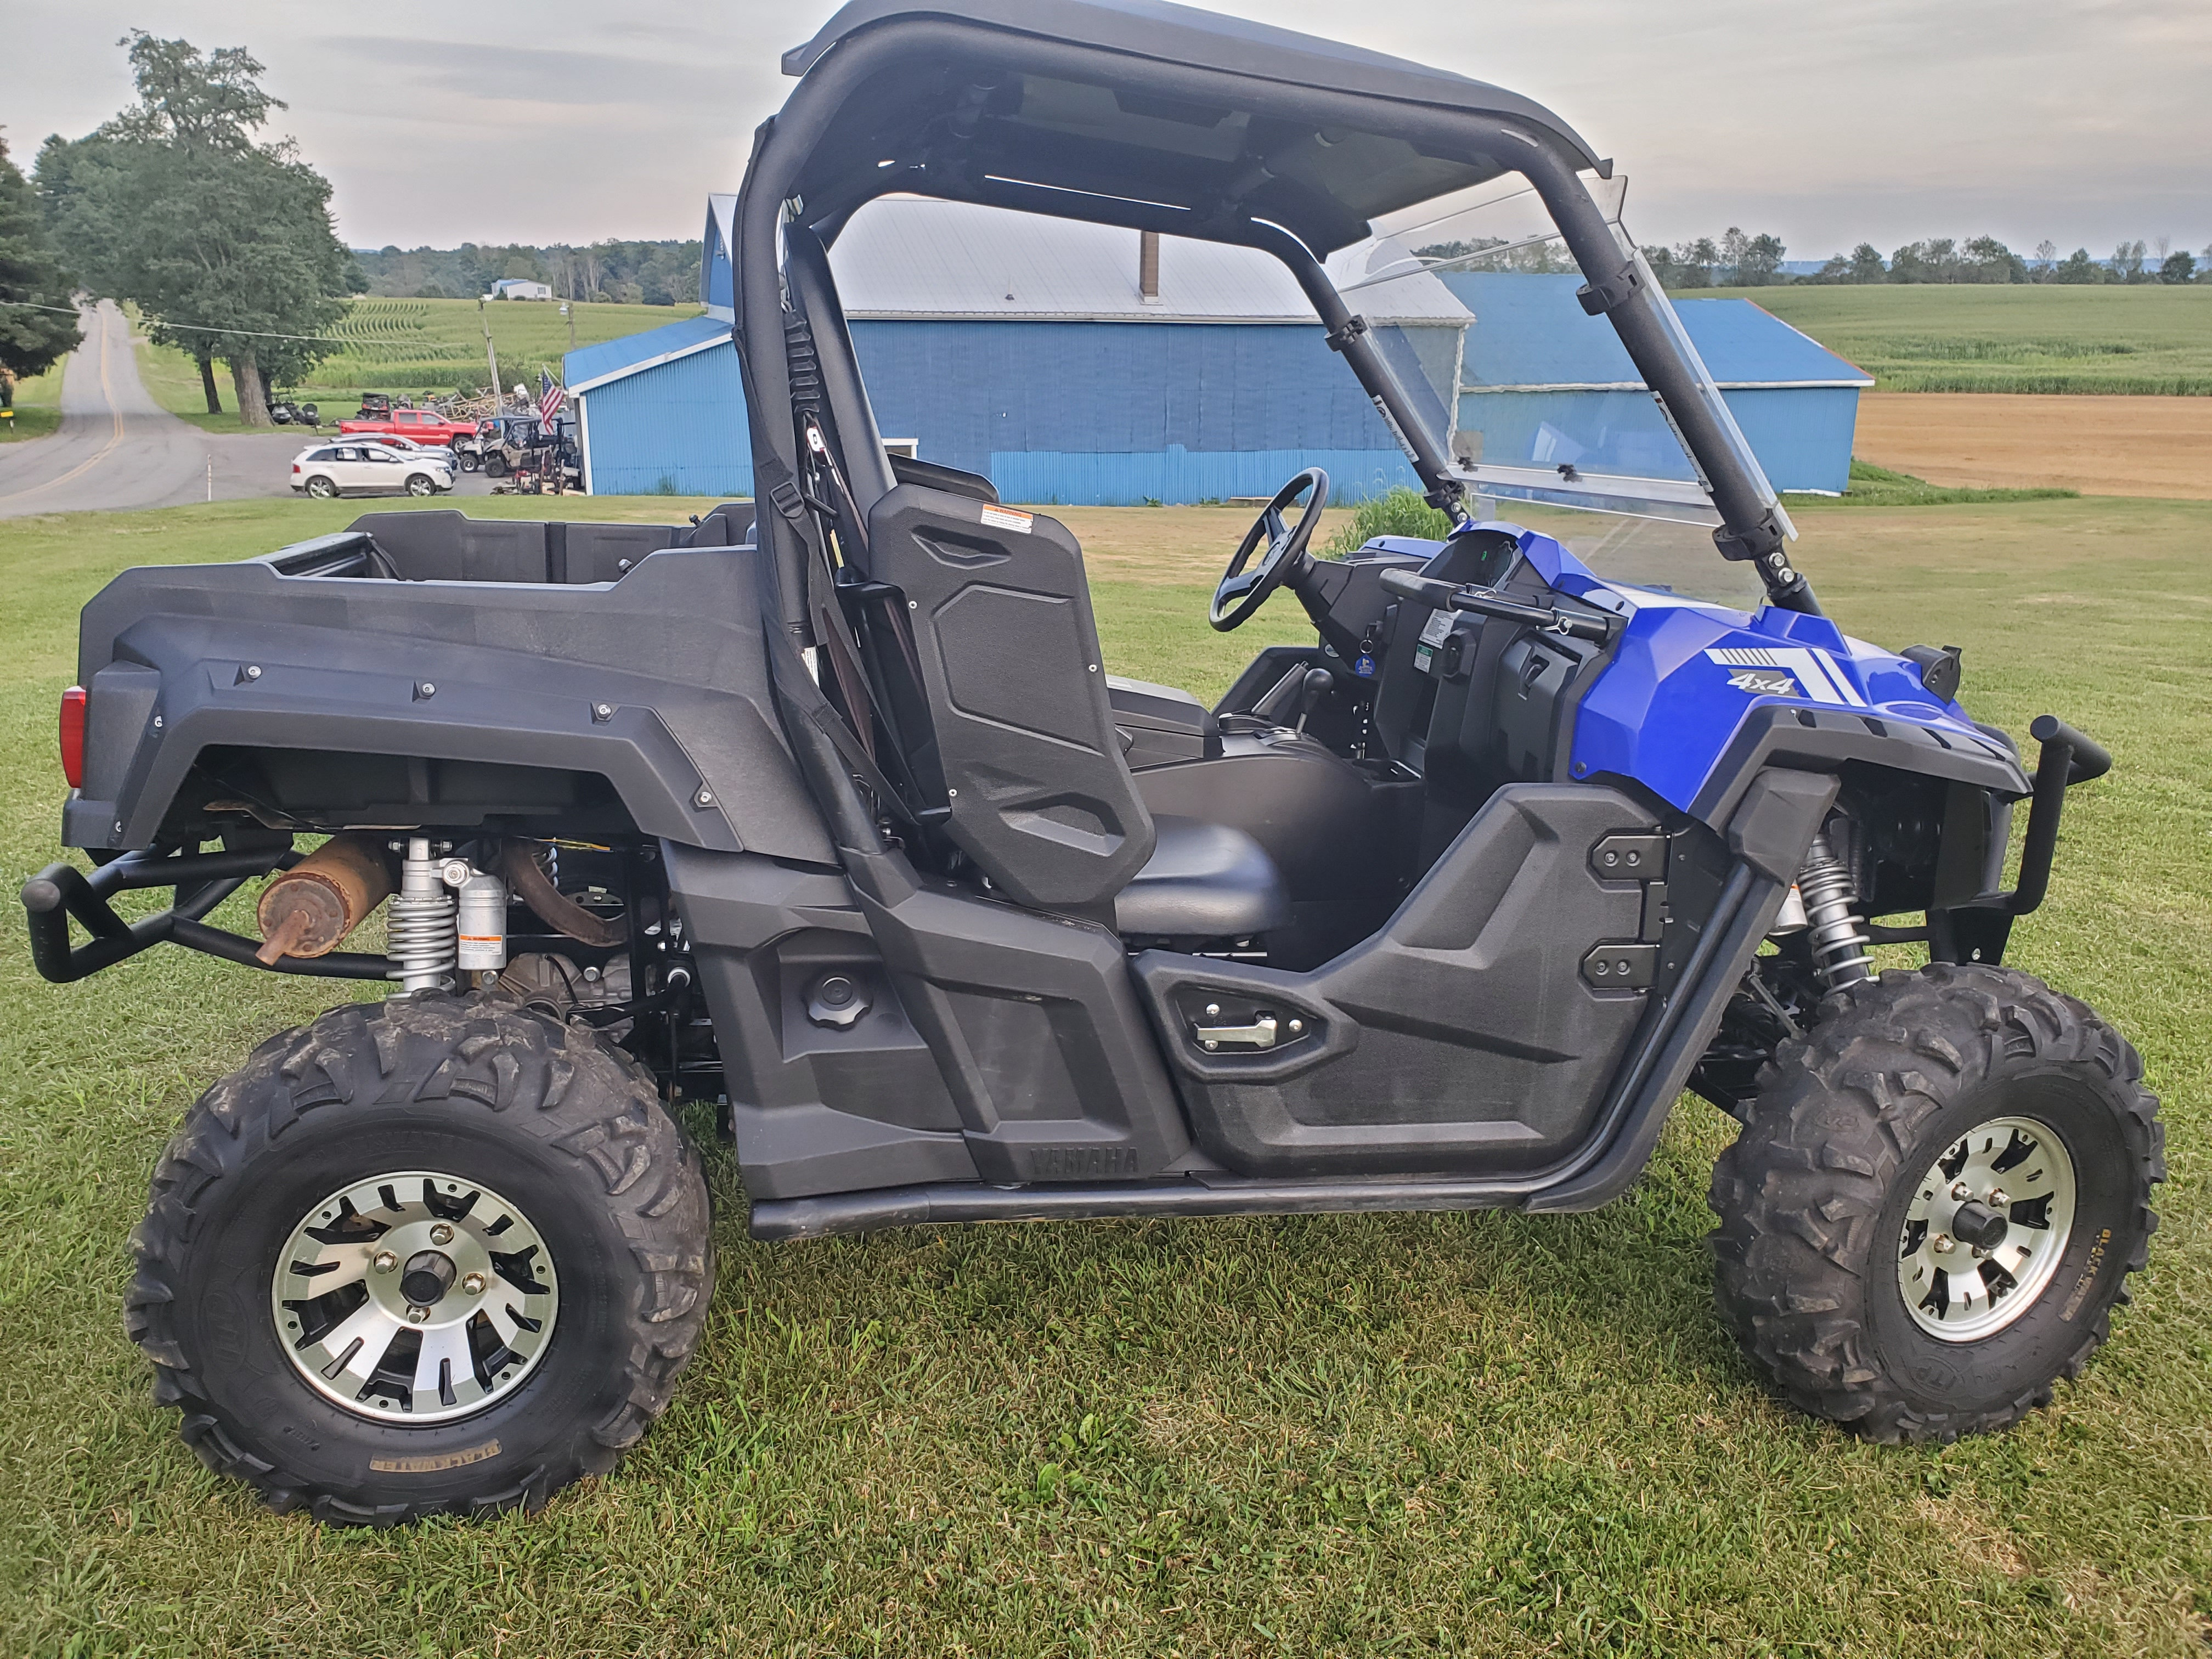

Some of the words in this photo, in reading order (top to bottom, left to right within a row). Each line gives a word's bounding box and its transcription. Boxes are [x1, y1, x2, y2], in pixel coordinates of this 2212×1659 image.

[999, 509, 1022, 517] WARNING
[1726, 673, 1795, 695] 4x4
[1030, 1147, 1139, 1175] YAMAHA
